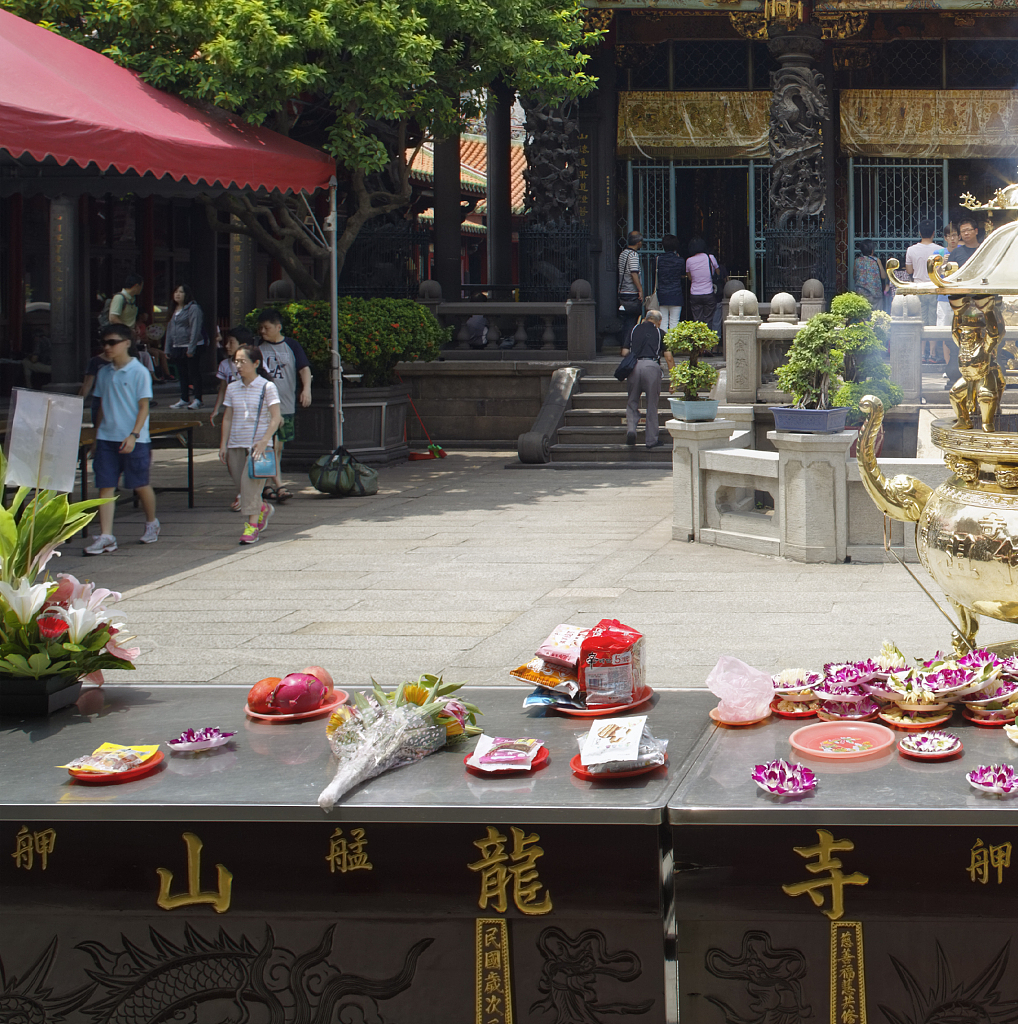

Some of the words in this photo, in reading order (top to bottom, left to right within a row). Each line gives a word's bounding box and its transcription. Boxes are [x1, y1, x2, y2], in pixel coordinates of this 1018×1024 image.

[467, 826, 554, 916] 龍
[484, 926, 504, 1024] 民國歲次
